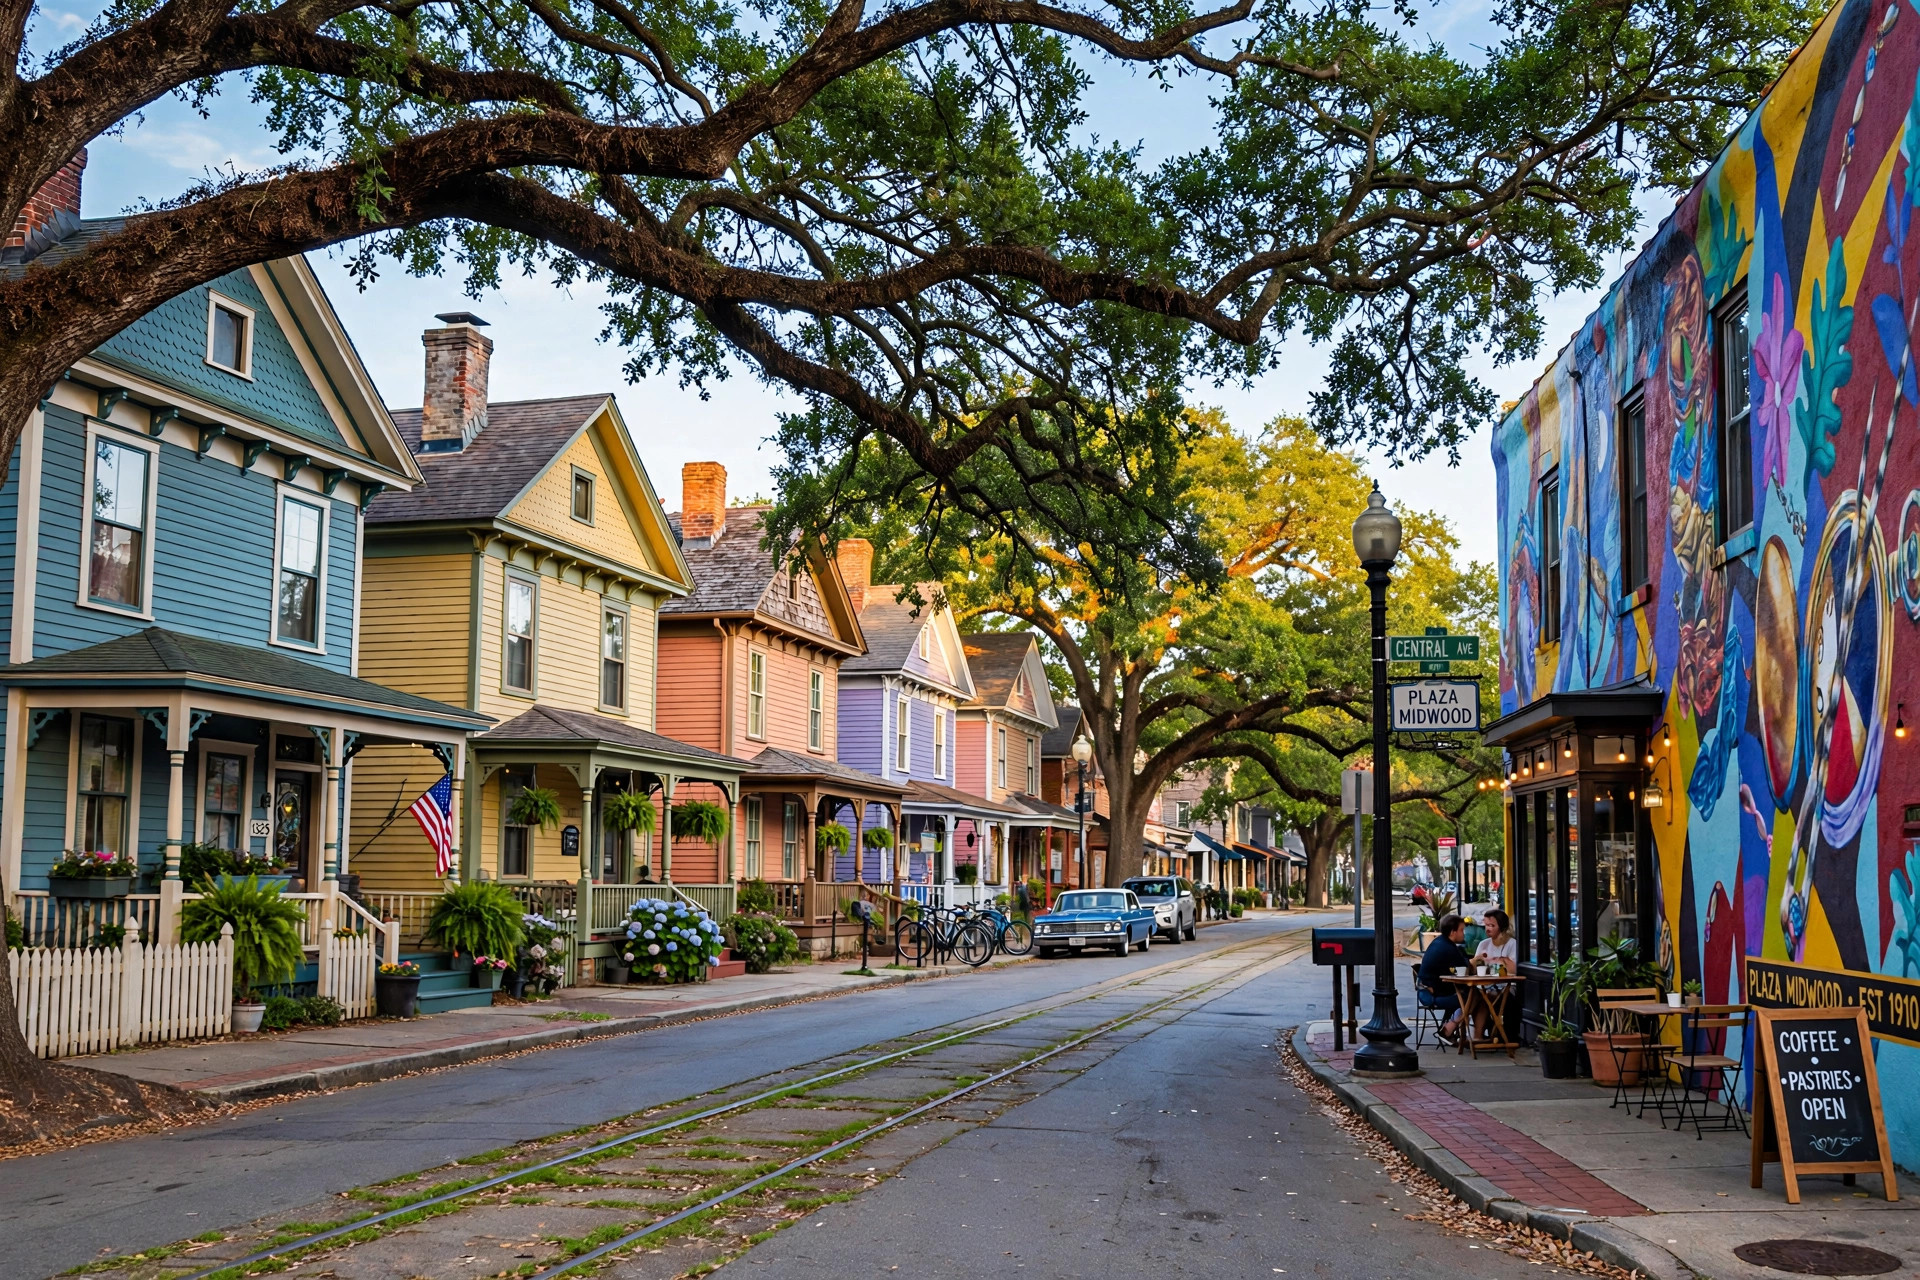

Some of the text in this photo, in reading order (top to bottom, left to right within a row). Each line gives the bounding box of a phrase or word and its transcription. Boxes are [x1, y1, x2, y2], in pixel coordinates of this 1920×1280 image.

[1395, 640, 1474, 658] CENTRAL AVE
[1408, 689, 1458, 705] PLAZA
[1399, 708, 1472, 725] MIDWOOD
[1749, 968, 1920, 1030] PLAZA MIDWOOD EST 1910
[1779, 1030, 1839, 1053] COFFEE
[1788, 1070, 1853, 1091] PASTRIES
[1801, 1097, 1847, 1121] OPEN
